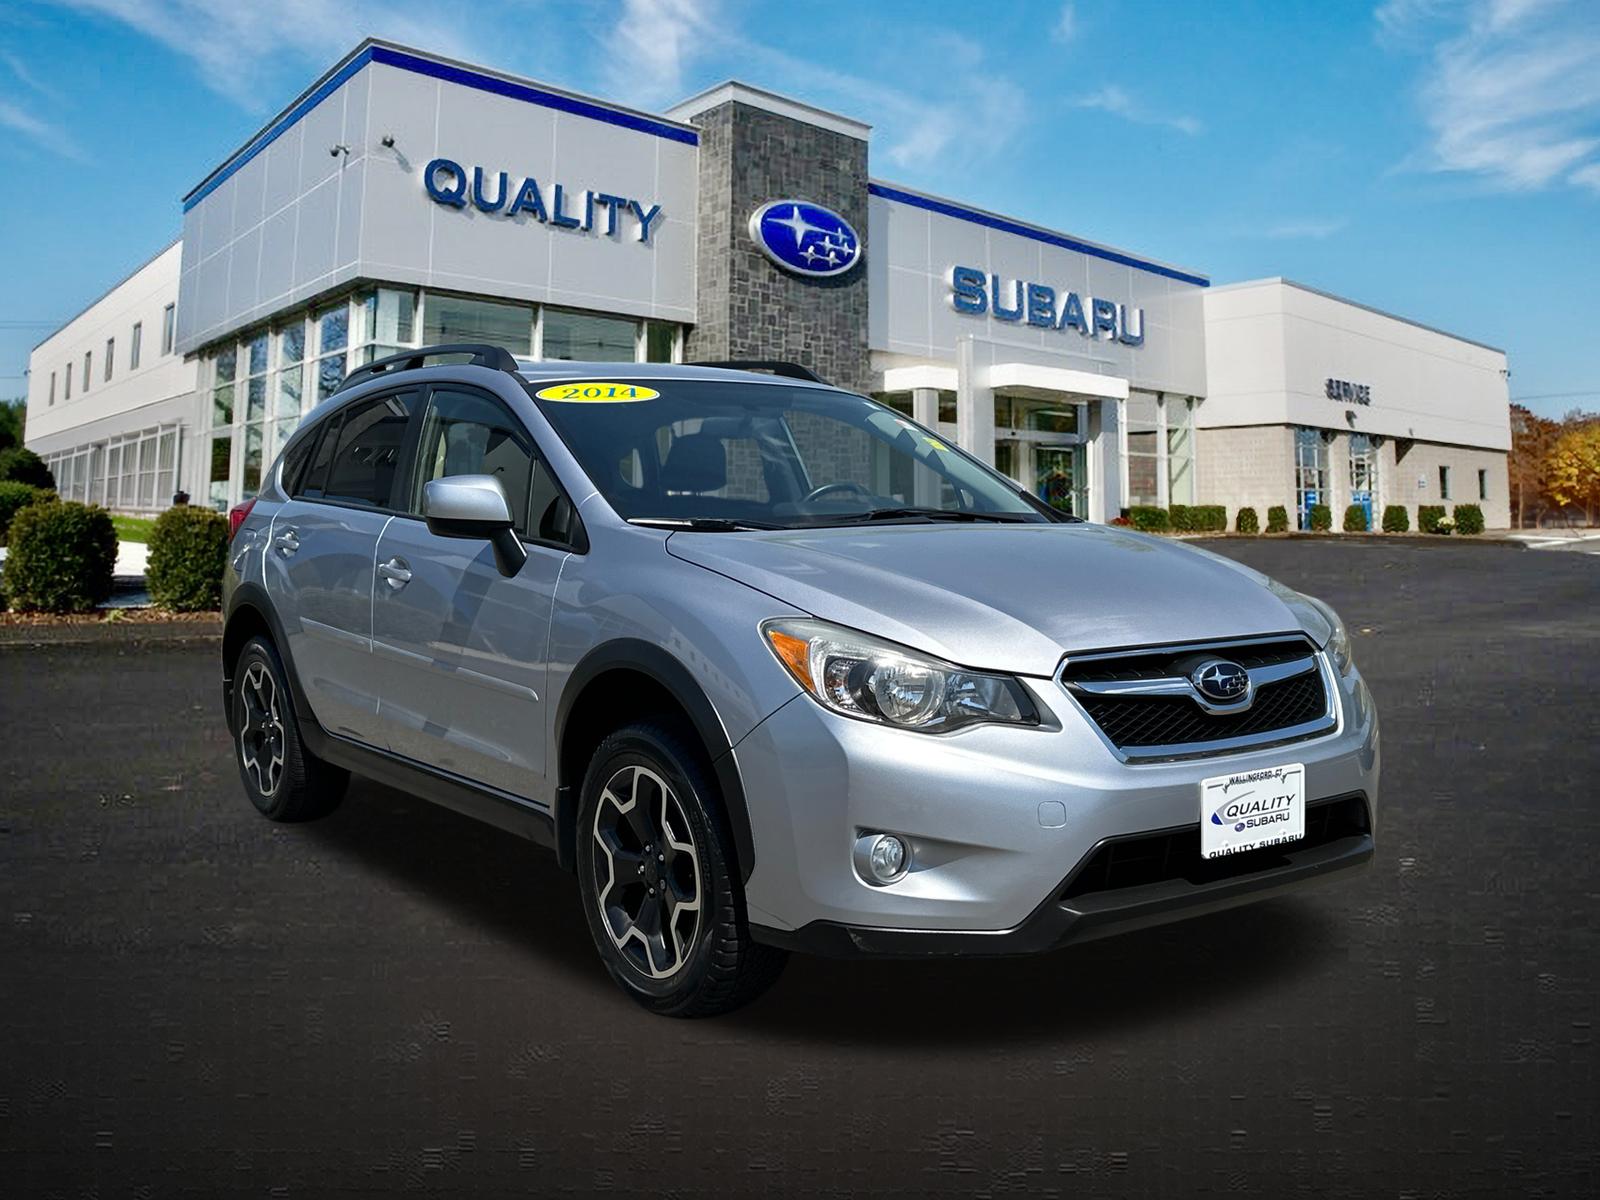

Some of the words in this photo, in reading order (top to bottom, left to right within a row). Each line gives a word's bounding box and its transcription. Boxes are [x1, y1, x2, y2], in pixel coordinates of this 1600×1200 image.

[424, 158, 661, 243] QUALITY
[952, 265, 1145, 347] SUBARU
[562, 387, 640, 399] 2014
[1325, 378, 1370, 406] SERVICE
[1226, 793, 1295, 818] QUALITY
[1246, 812, 1290, 828] SUBARU
[1209, 843, 1256, 858] QUALITY
[1259, 833, 1302, 847] SUBARU
